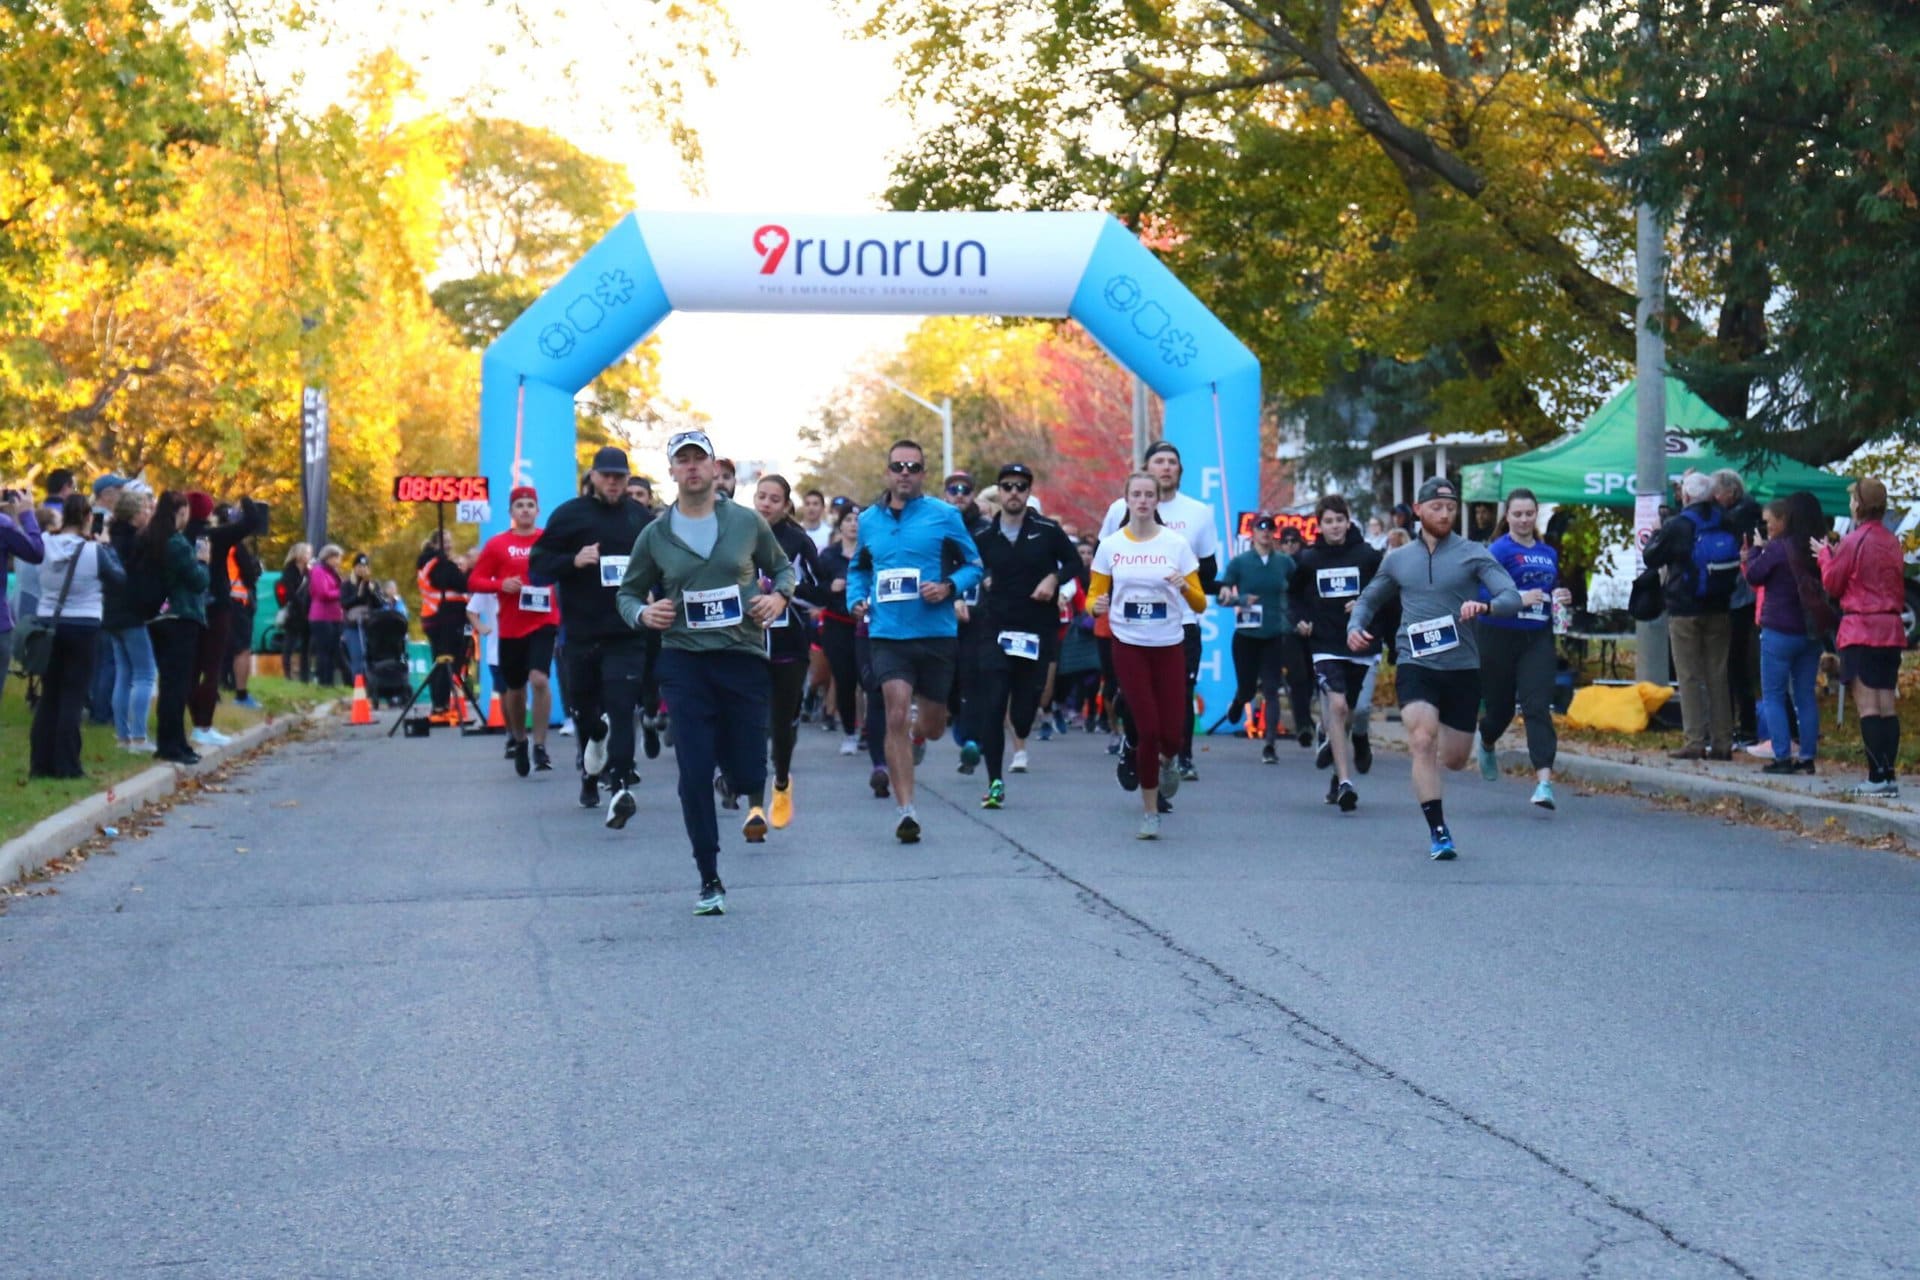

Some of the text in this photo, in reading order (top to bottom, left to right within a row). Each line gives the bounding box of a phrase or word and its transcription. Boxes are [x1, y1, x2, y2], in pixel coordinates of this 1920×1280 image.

[752, 224, 987, 277] 9runrun
[759, 285, 785, 296] THE
[791, 285, 875, 296] EMERGENCY
[959, 285, 989, 296] RUN
[397, 476, 488, 501] 08:05:05
[461, 504, 484, 521] 5K
[1112, 553, 1167, 567] 9runrun
[702, 600, 724, 616] 734
[1423, 629, 1442, 644] 650
